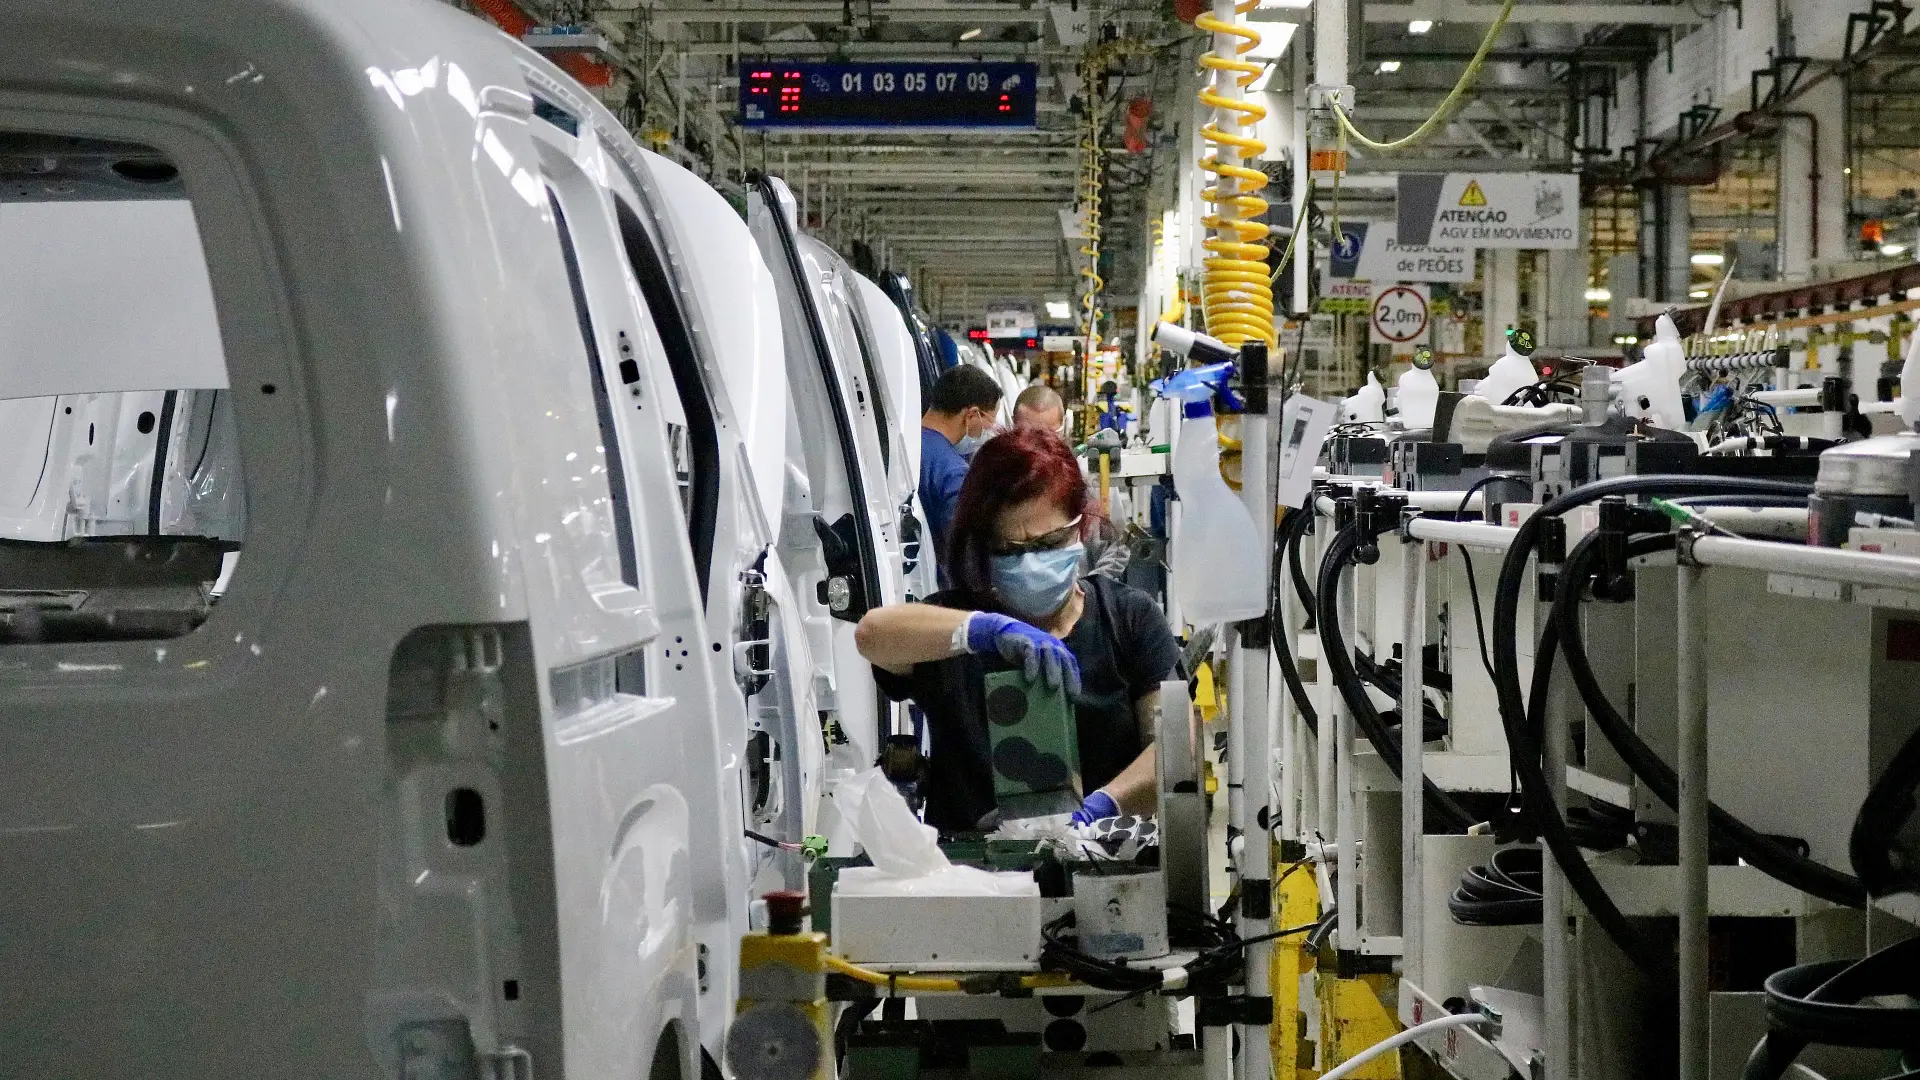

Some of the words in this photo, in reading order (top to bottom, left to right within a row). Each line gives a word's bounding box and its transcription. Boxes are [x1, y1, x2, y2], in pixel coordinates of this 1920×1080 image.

[842, 73, 862, 92] 01
[873, 73, 895, 92] 03
[904, 73, 926, 92] 05
[936, 73, 958, 92] 07
[967, 73, 989, 92] 09
[1439, 208, 1508, 225] ATENÇÃO
[1440, 227, 1468, 239] AGV
[1472, 227, 1491, 239] EM
[1494, 227, 1573, 240] MOVIMENTO
[1397, 258, 1415, 272] de
[1379, 305, 1422, 324] 2,0m
